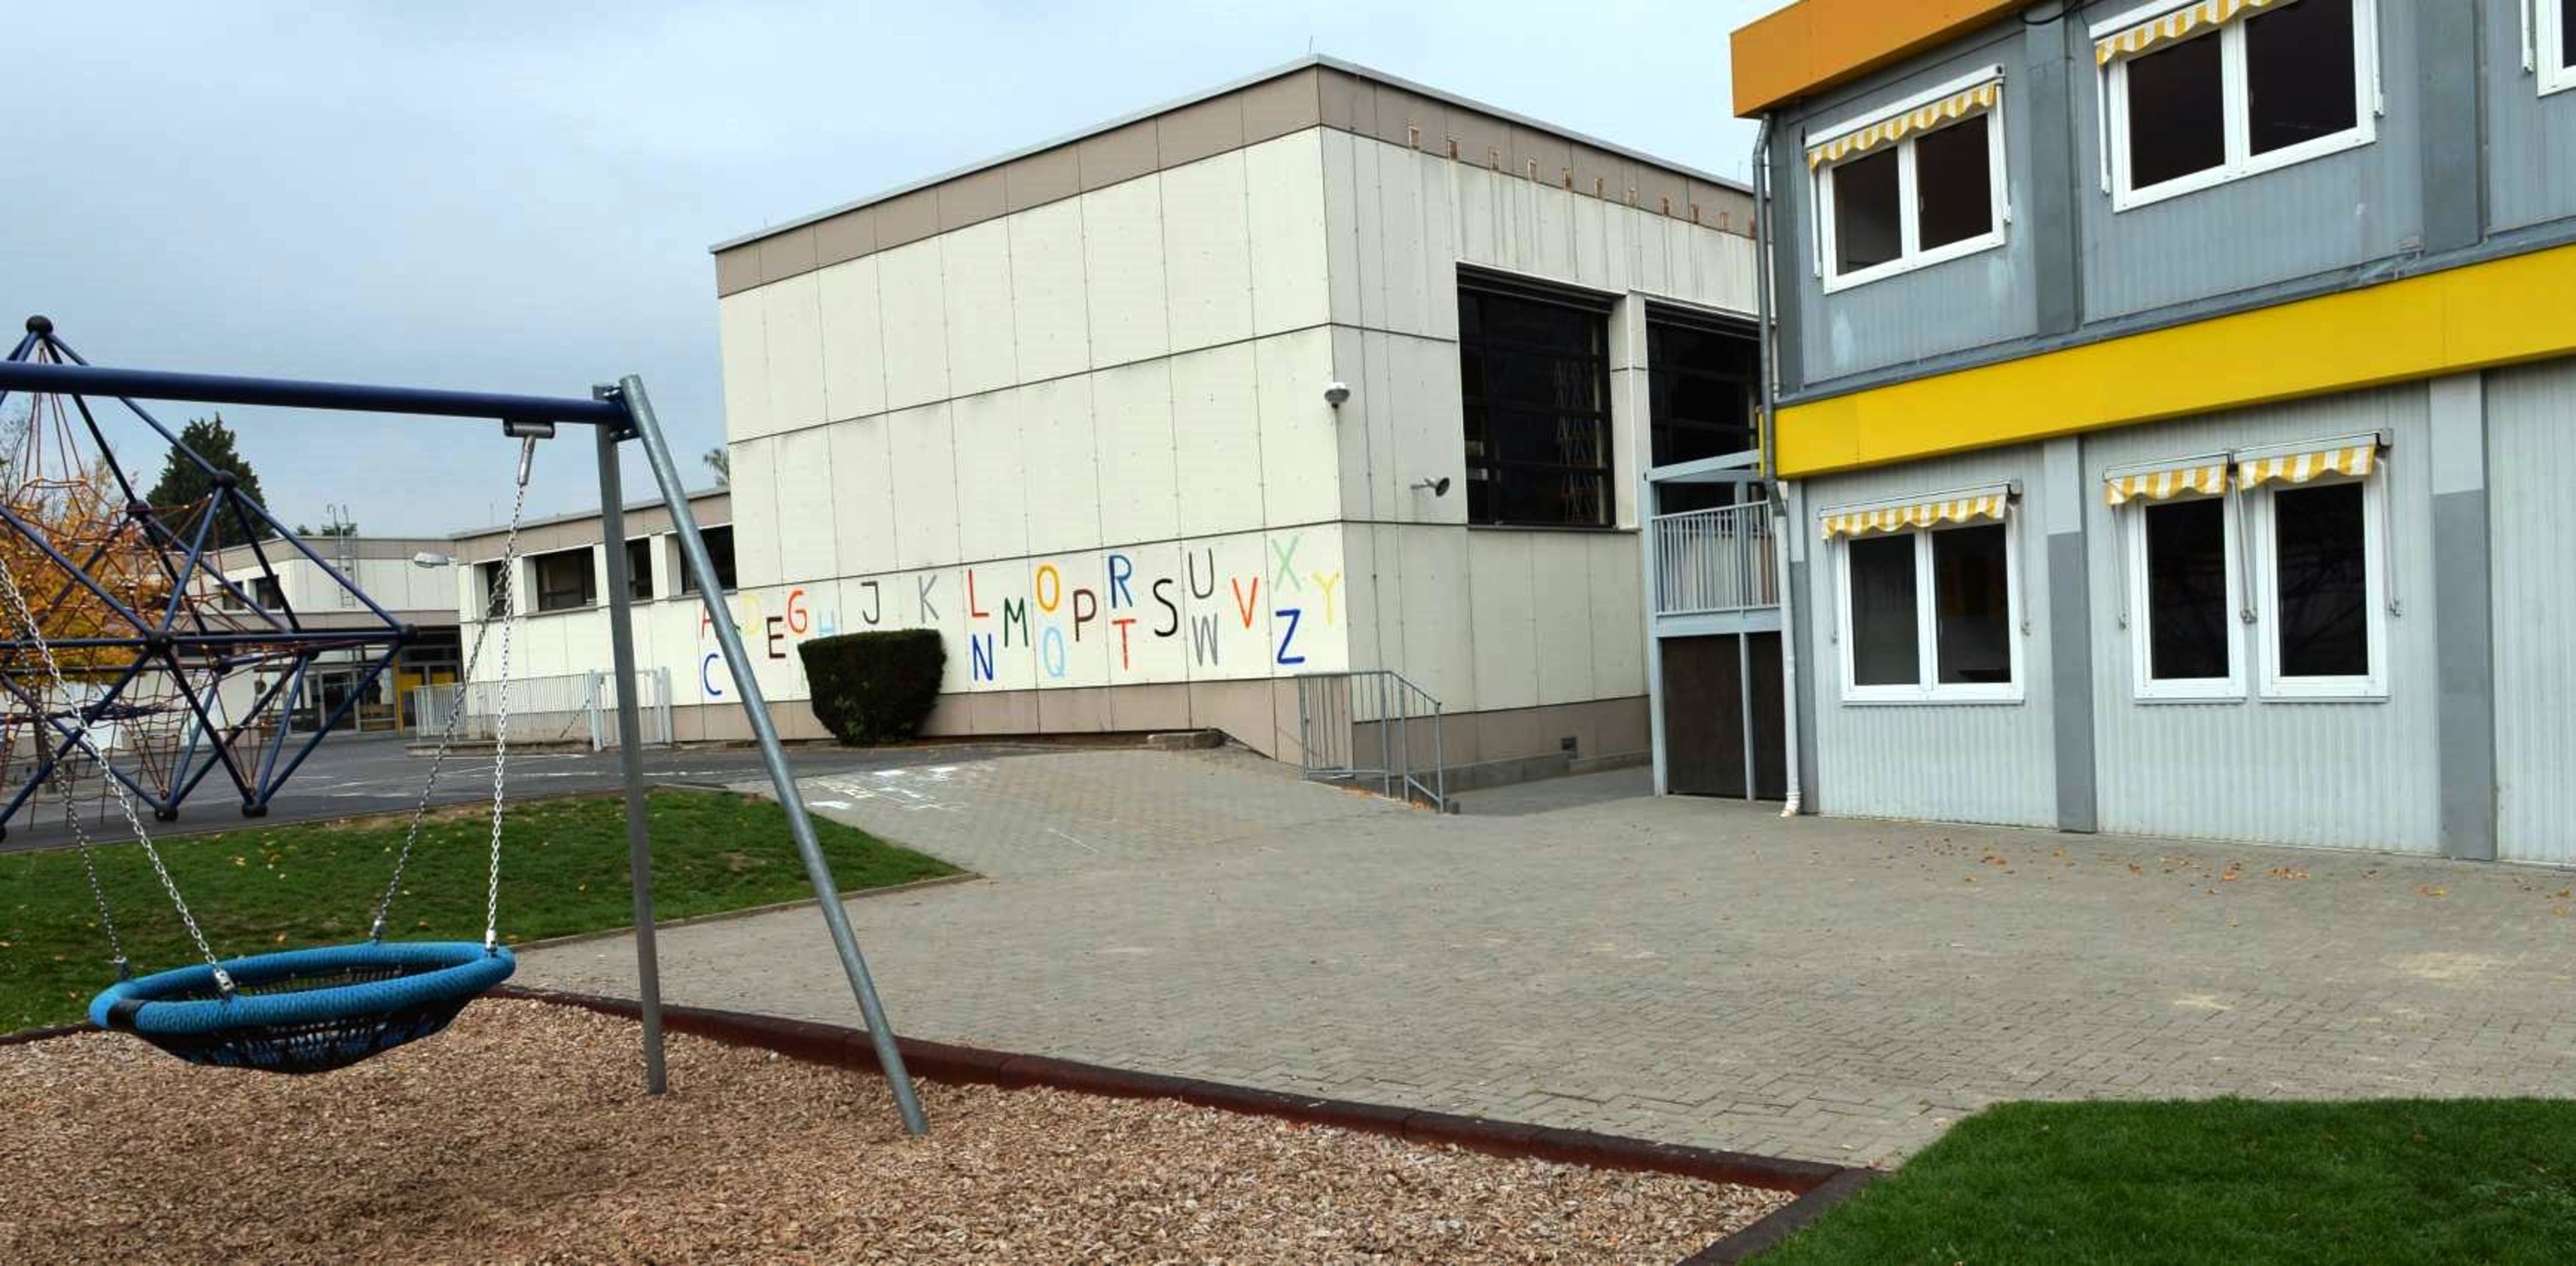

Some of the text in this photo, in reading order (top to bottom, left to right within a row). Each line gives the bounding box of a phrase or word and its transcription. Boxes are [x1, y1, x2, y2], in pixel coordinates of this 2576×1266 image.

[1036, 564, 1061, 613] O
[1108, 555, 1133, 609] R
[1188, 548, 1214, 600] U
[1273, 535, 1302, 593] X
[787, 589, 808, 634] G
[861, 581, 880, 625] J
[918, 574, 939, 624] K
[969, 569, 989, 618] L
[1073, 588, 1097, 642] P
[1153, 578, 1178, 637] S
[1232, 576, 1258, 629] V
[1313, 570, 1340, 625] Y
[767, 617, 786, 659] E
[1004, 597, 1028, 647] M
[1112, 618, 1136, 670] T
[1191, 613, 1218, 667] W
[1275, 609, 1305, 665] Z
[704, 653, 722, 696] C
[973, 633, 994, 680] N
[1042, 626, 1065, 678] Q
